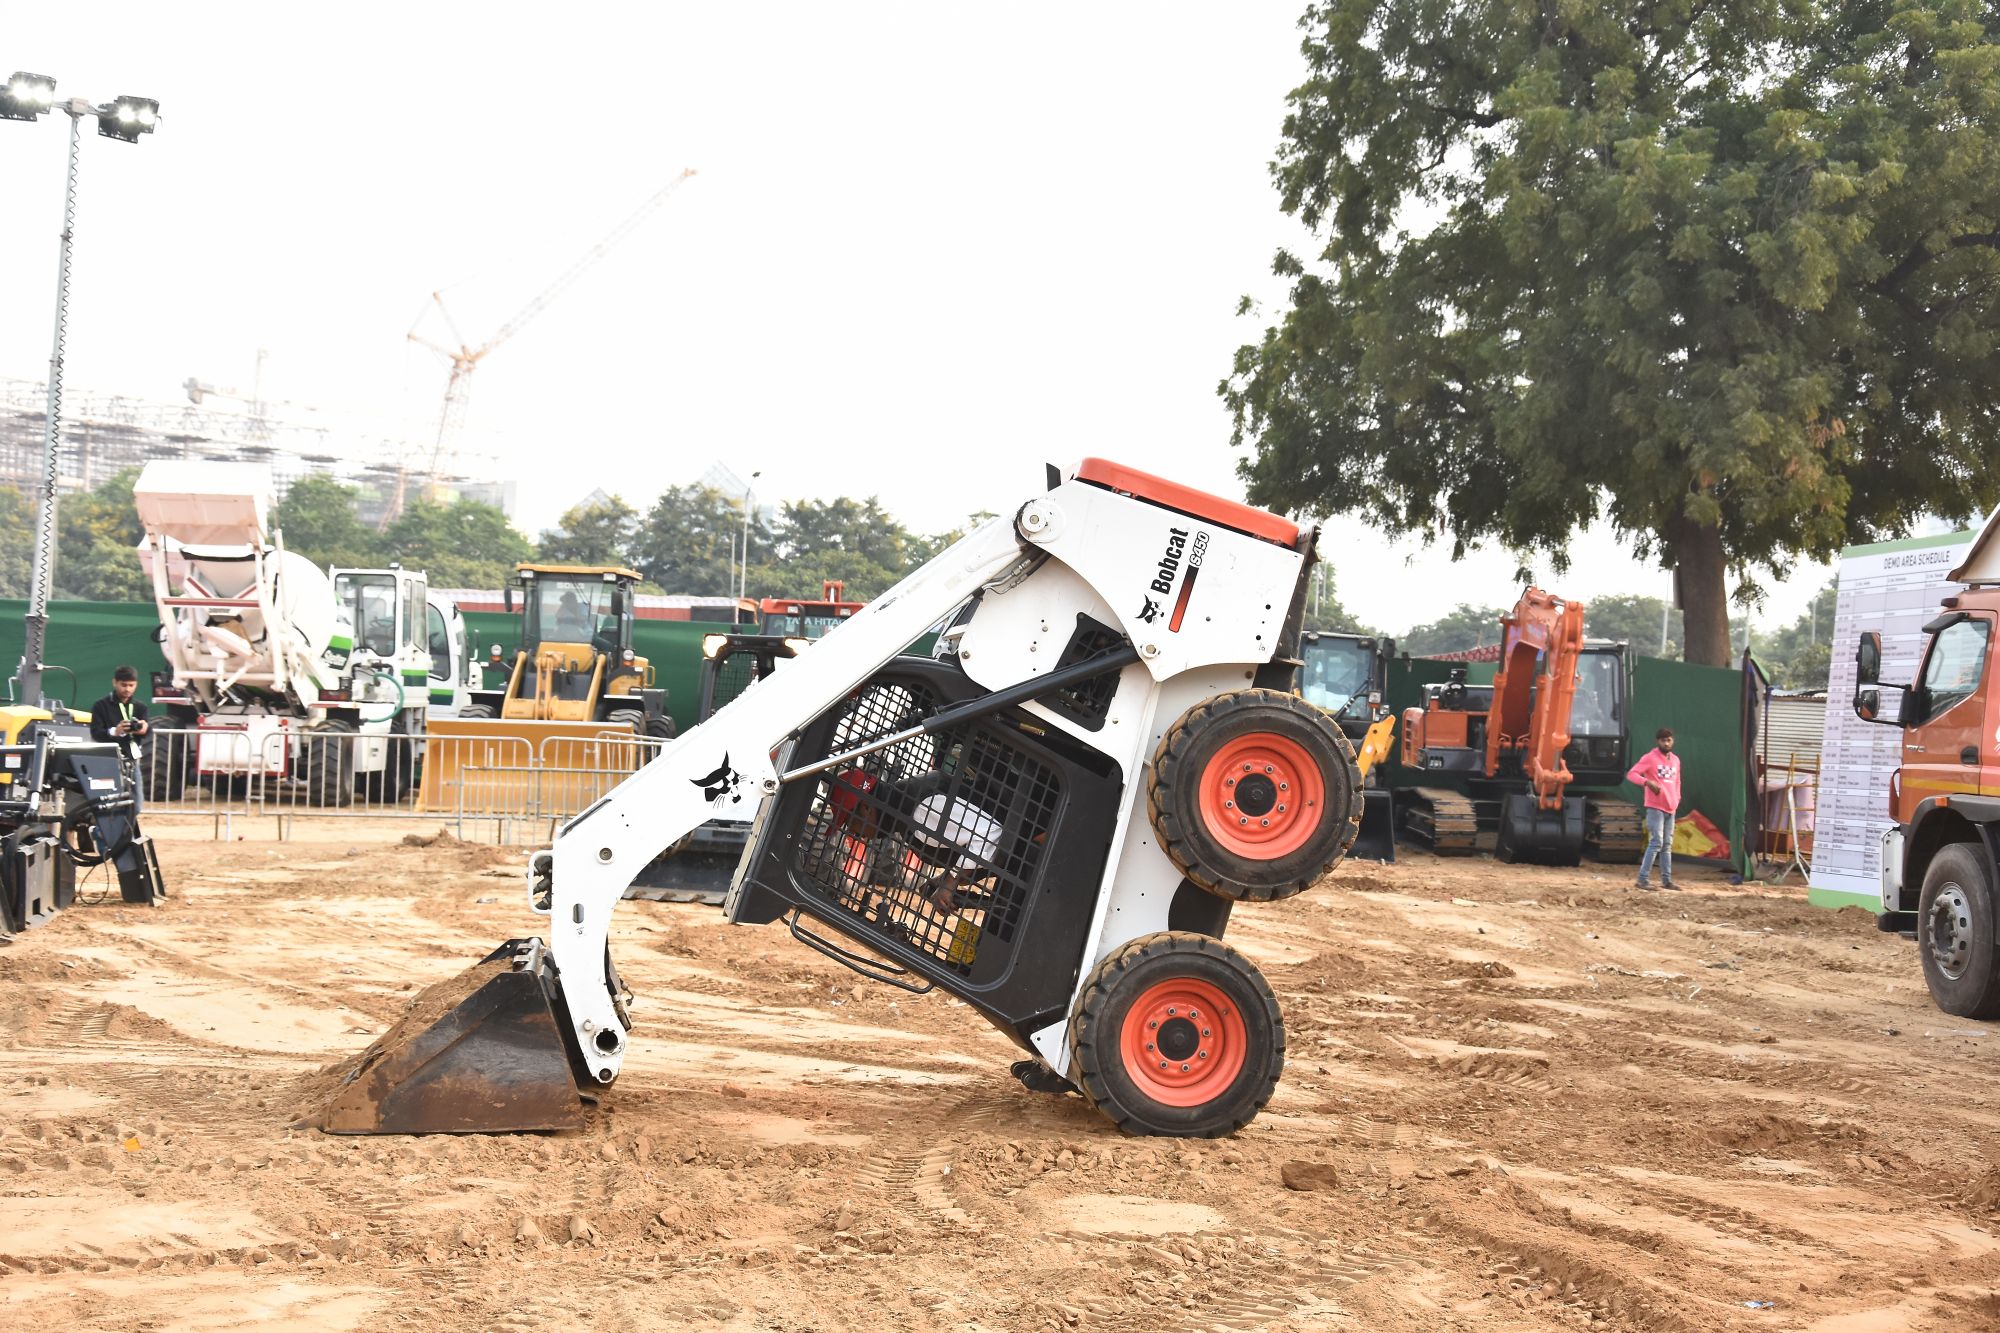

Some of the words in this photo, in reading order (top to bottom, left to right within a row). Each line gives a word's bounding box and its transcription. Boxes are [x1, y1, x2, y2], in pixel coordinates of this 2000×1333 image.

[1150, 527, 1189, 595] Bobcat
[1189, 531, 1210, 567] S450
[1883, 556, 1901, 570] DEMO
[1901, 554, 1917, 567] AREA
[1918, 550, 1950, 566] SCHEDULE
[785, 616, 812, 625] TAA
